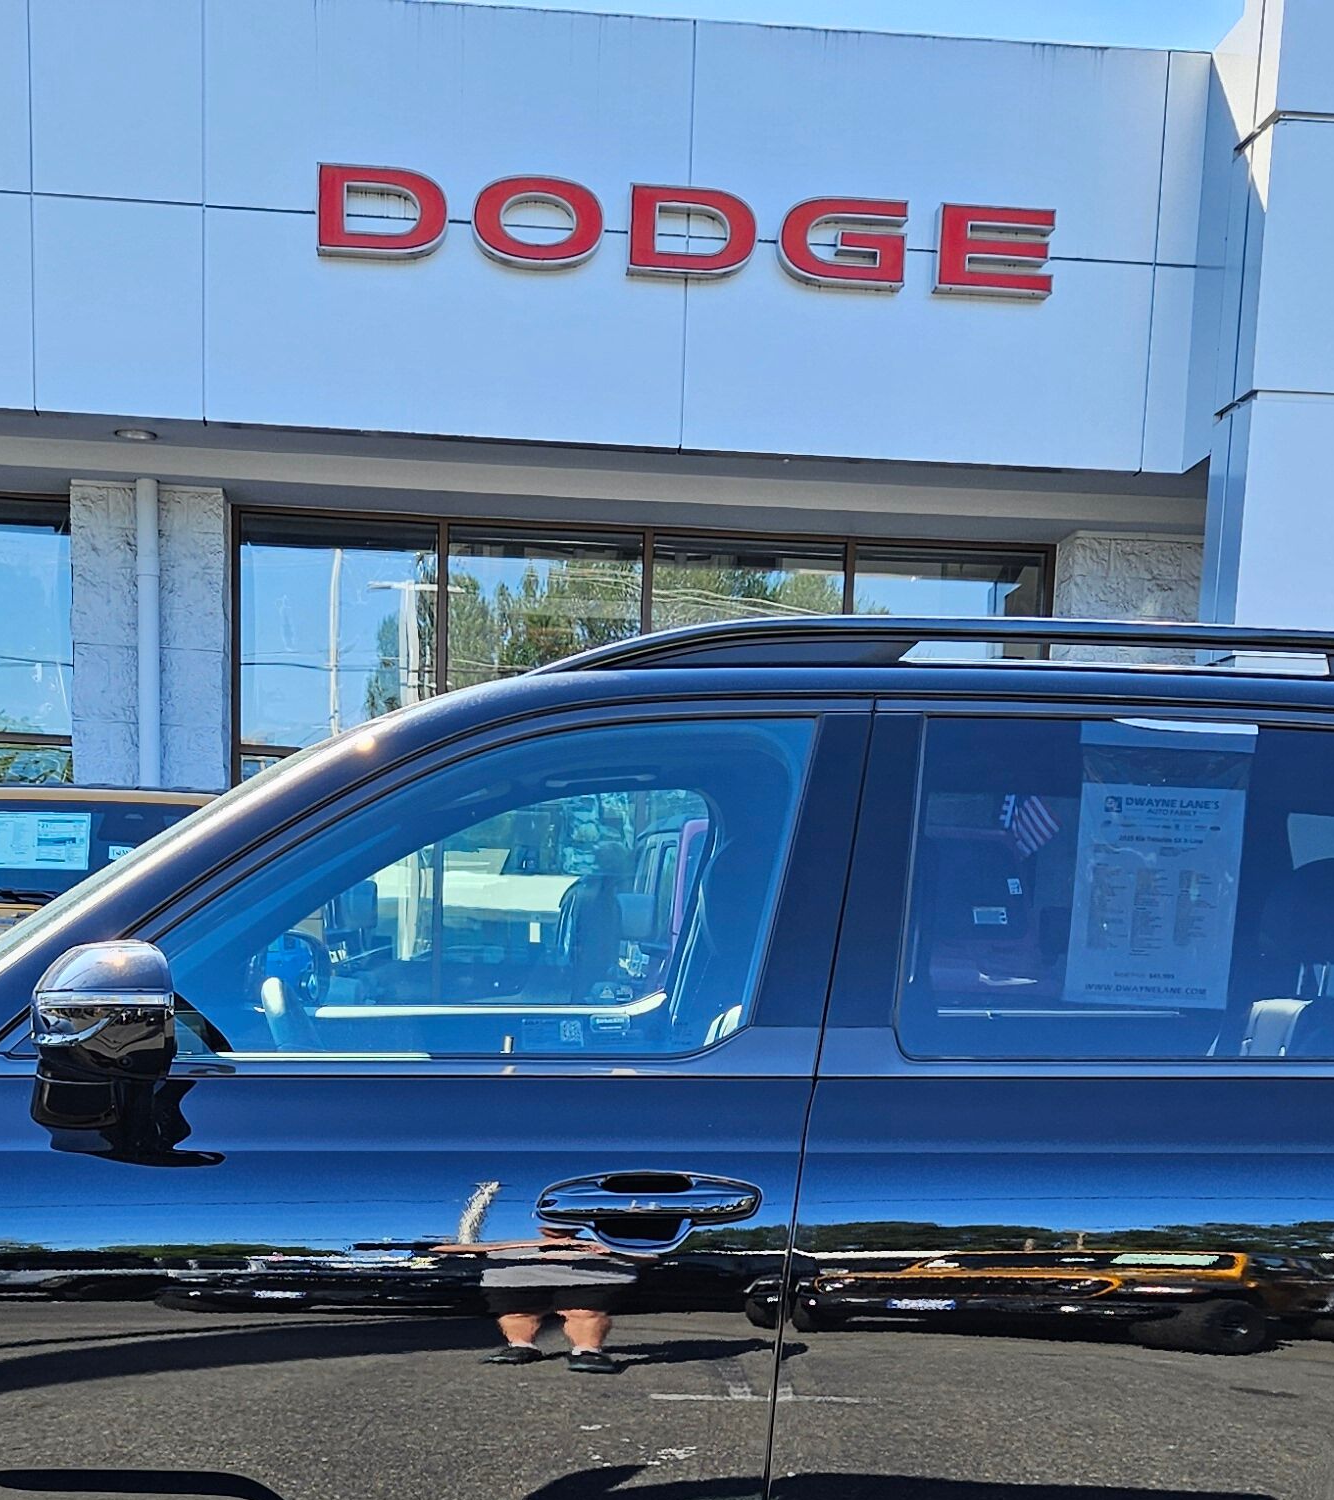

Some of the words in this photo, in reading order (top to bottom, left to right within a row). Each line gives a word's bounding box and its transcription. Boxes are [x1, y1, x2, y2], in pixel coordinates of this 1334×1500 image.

[317, 161, 1057, 298] DODGE
[1125, 797, 1178, 808] DWAYNE
[1179, 799, 1220, 810] LANE'S
